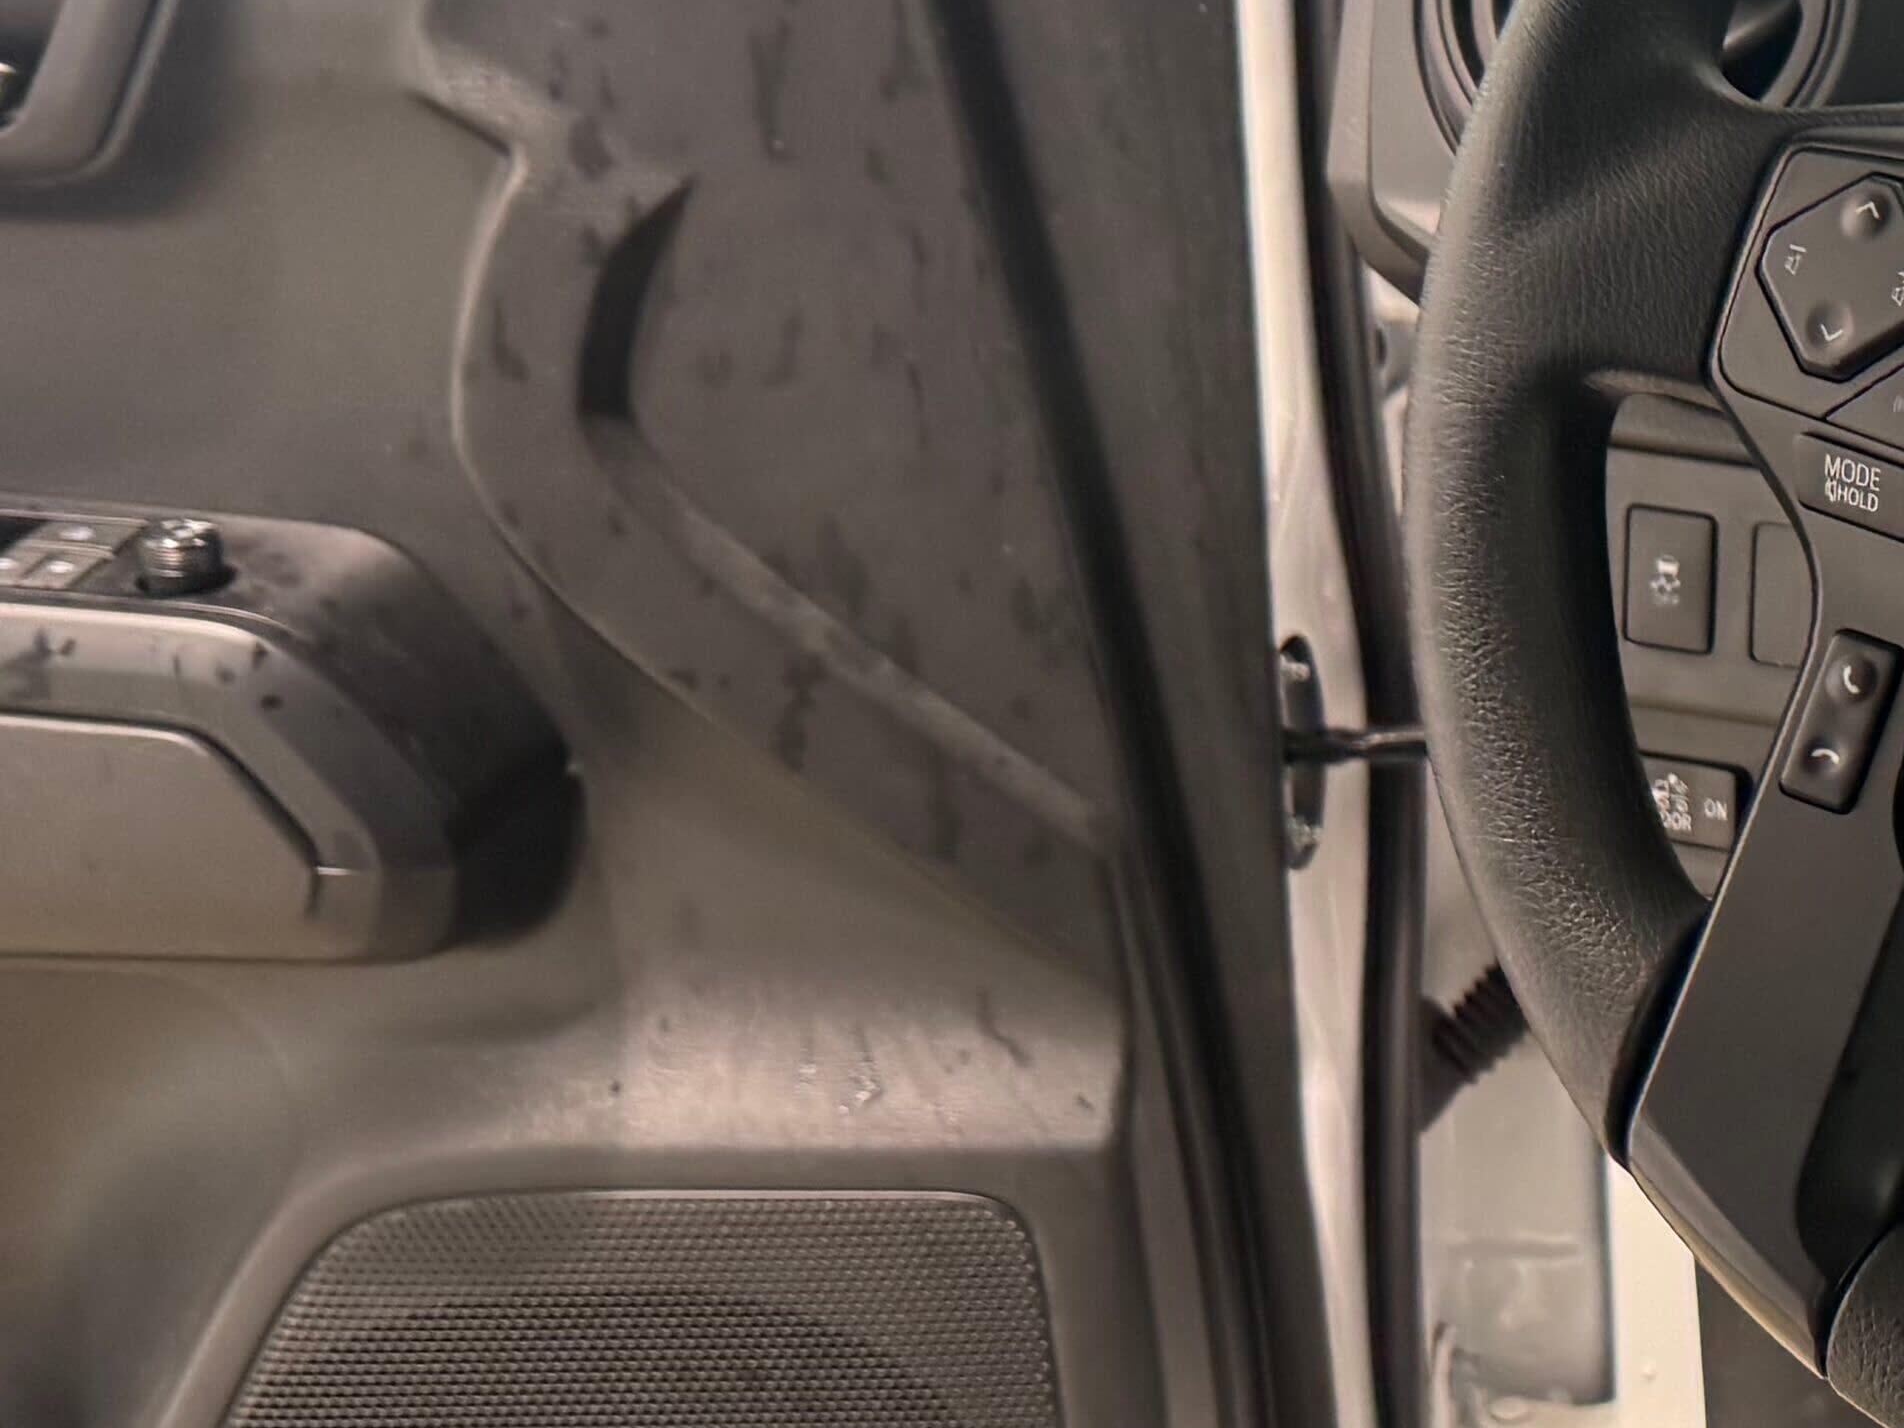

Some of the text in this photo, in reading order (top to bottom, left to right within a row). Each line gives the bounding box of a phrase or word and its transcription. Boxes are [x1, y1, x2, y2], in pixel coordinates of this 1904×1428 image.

[1824, 453, 1881, 492] MODE
[1837, 483, 1879, 512] HOLD
[1703, 798, 1728, 821] ON
